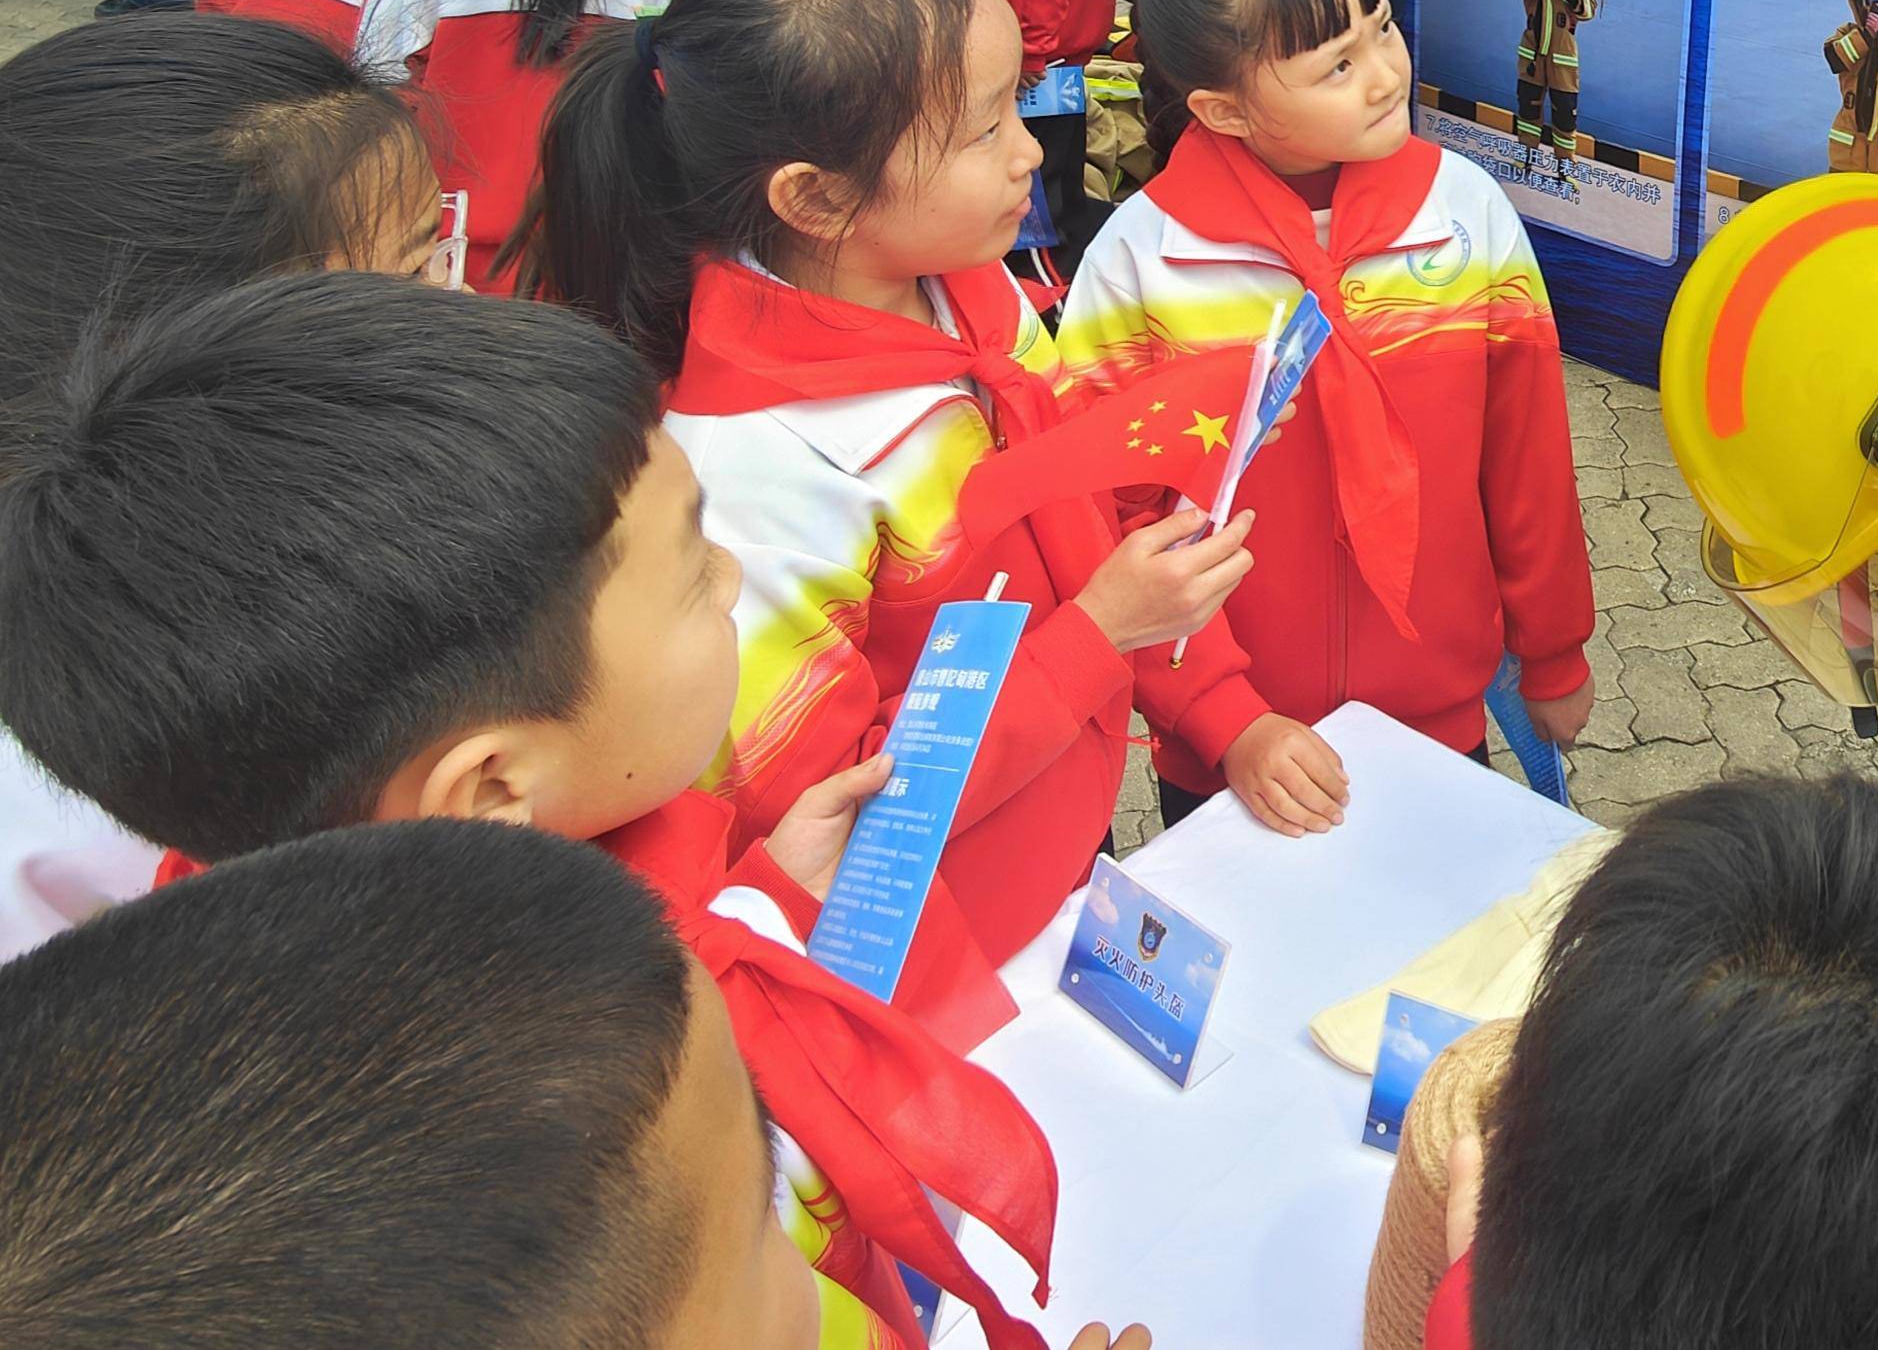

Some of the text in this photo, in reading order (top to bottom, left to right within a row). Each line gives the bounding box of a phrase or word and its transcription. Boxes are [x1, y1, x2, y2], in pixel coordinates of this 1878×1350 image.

[1425, 114, 1661, 205] 7.将空气呼吸器压力表置于衣内并
[1092, 934, 1185, 1022] 灭火防护头盔
